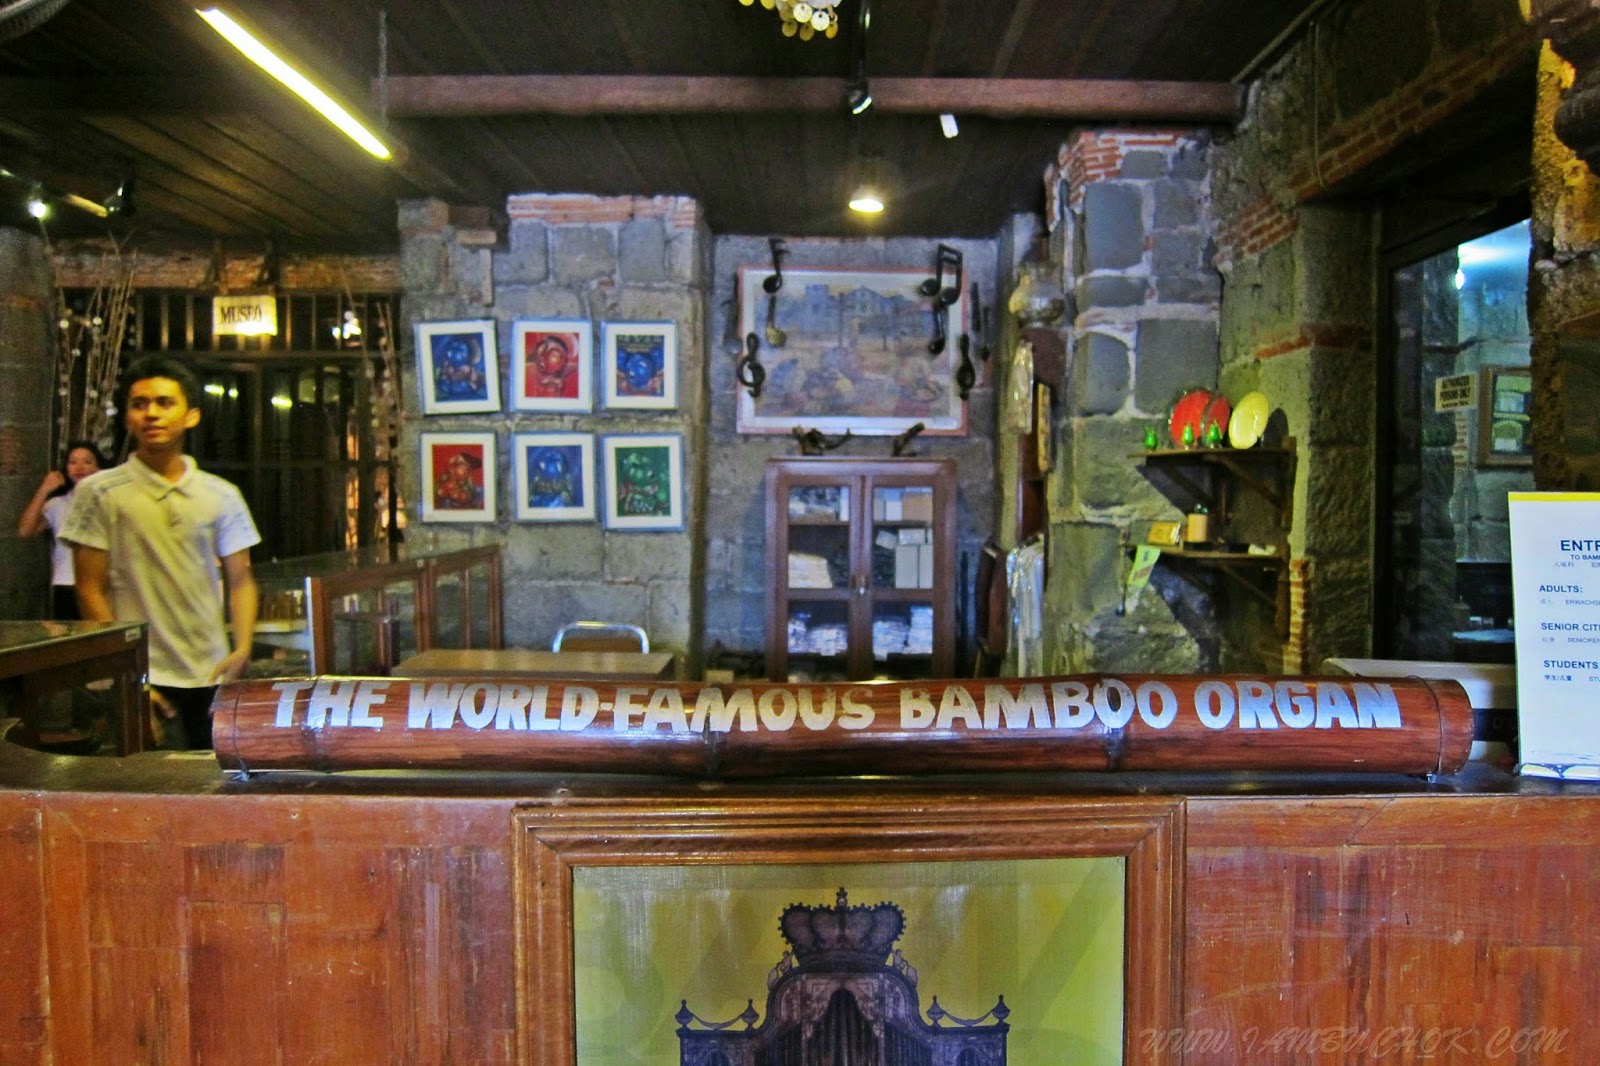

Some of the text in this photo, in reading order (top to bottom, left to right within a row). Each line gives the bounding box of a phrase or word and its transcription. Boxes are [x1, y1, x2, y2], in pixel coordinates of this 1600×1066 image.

[1539, 585, 1583, 593] ADULTS:
[1541, 622, 1580, 631] SENIOR
[1543, 659, 1599, 669] STUDENTS
[272, 678, 1403, 732] THE WORLD-FAMOUS BAMBOO ORGAN
